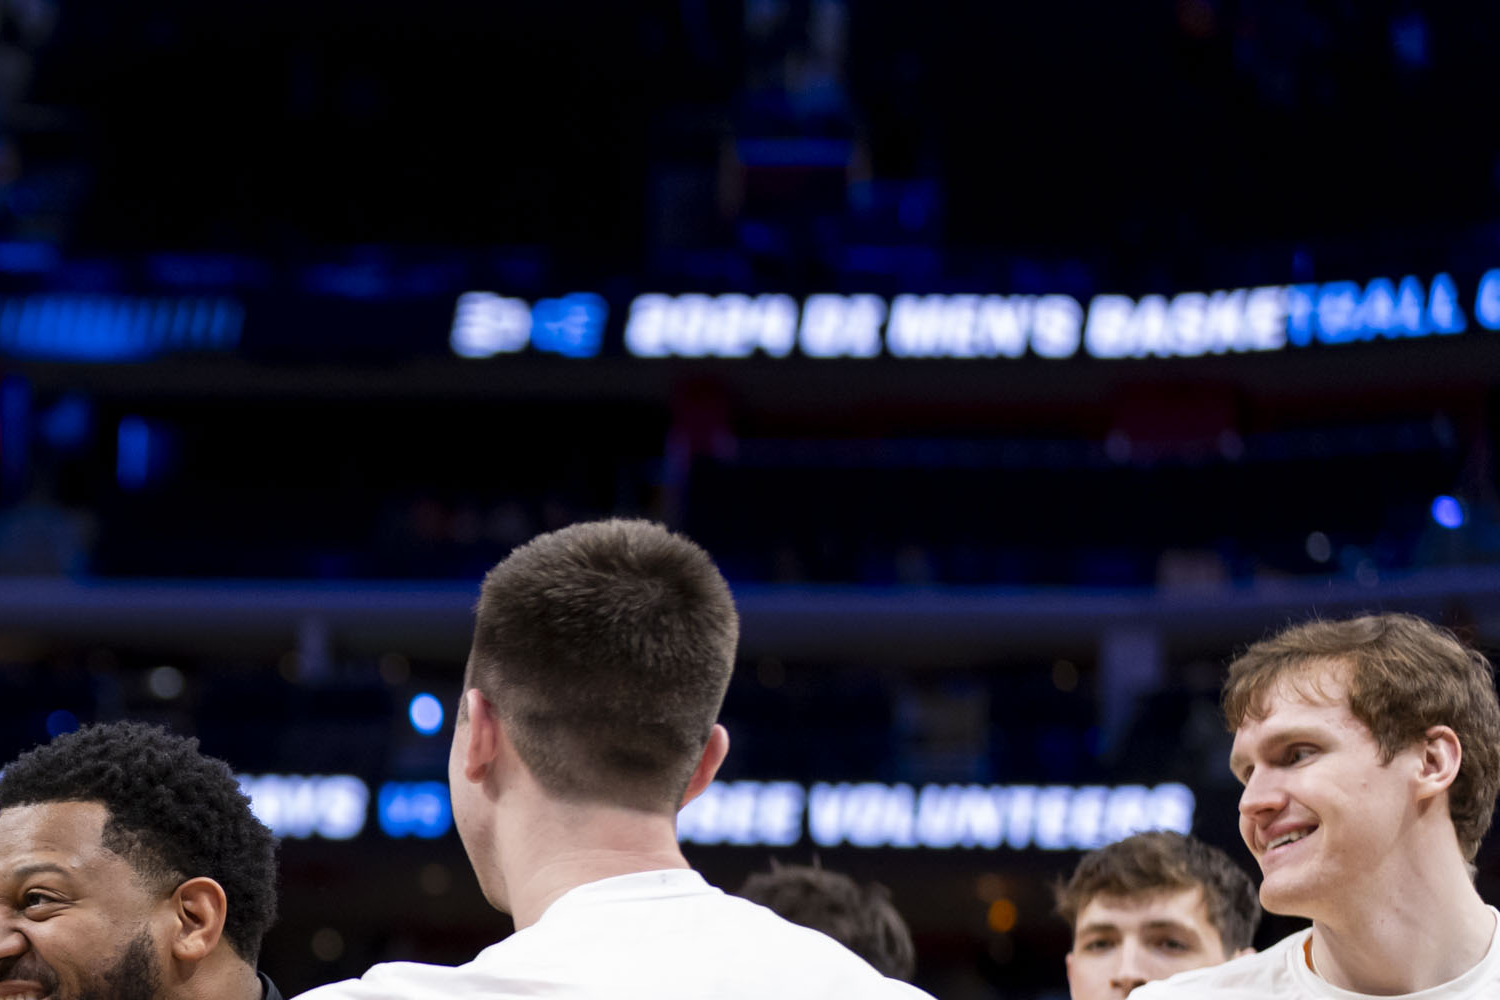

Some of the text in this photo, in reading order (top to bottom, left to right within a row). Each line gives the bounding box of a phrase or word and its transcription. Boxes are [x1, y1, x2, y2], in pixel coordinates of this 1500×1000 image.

[887, 292, 1084, 359] MEN'S
[1084, 272, 1467, 359] BASKETBALL
[808, 781, 1195, 850] VOLUNTEERS
